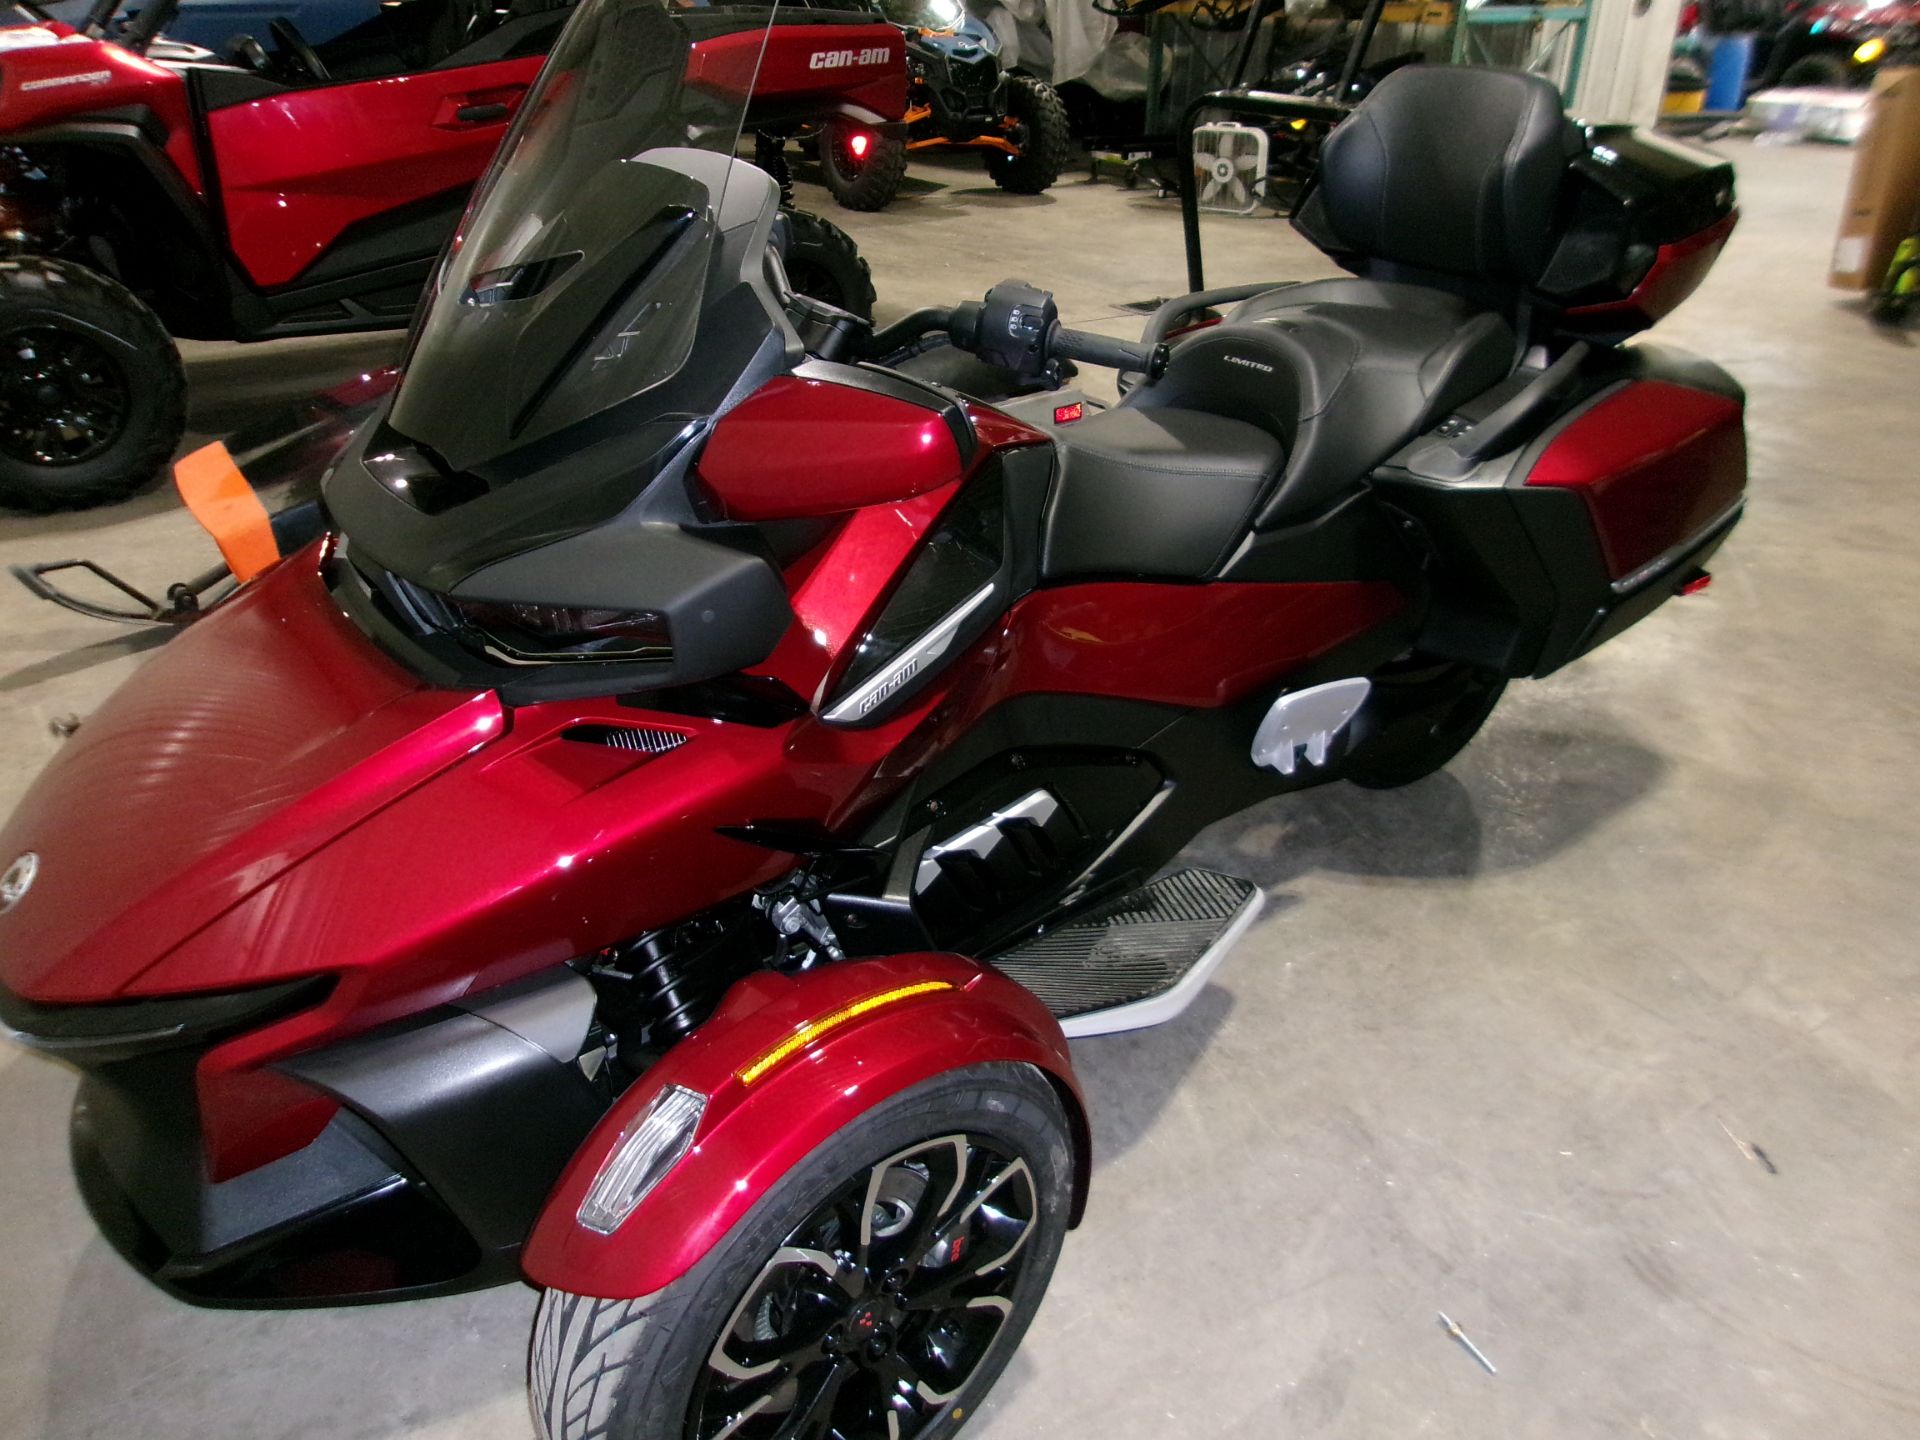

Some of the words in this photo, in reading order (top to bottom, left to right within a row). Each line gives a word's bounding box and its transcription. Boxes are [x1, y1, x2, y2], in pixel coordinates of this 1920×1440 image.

[809, 47, 890, 70] can-am
[1223, 355, 1273, 372] LIMITED
[859, 657, 918, 715] can-am
